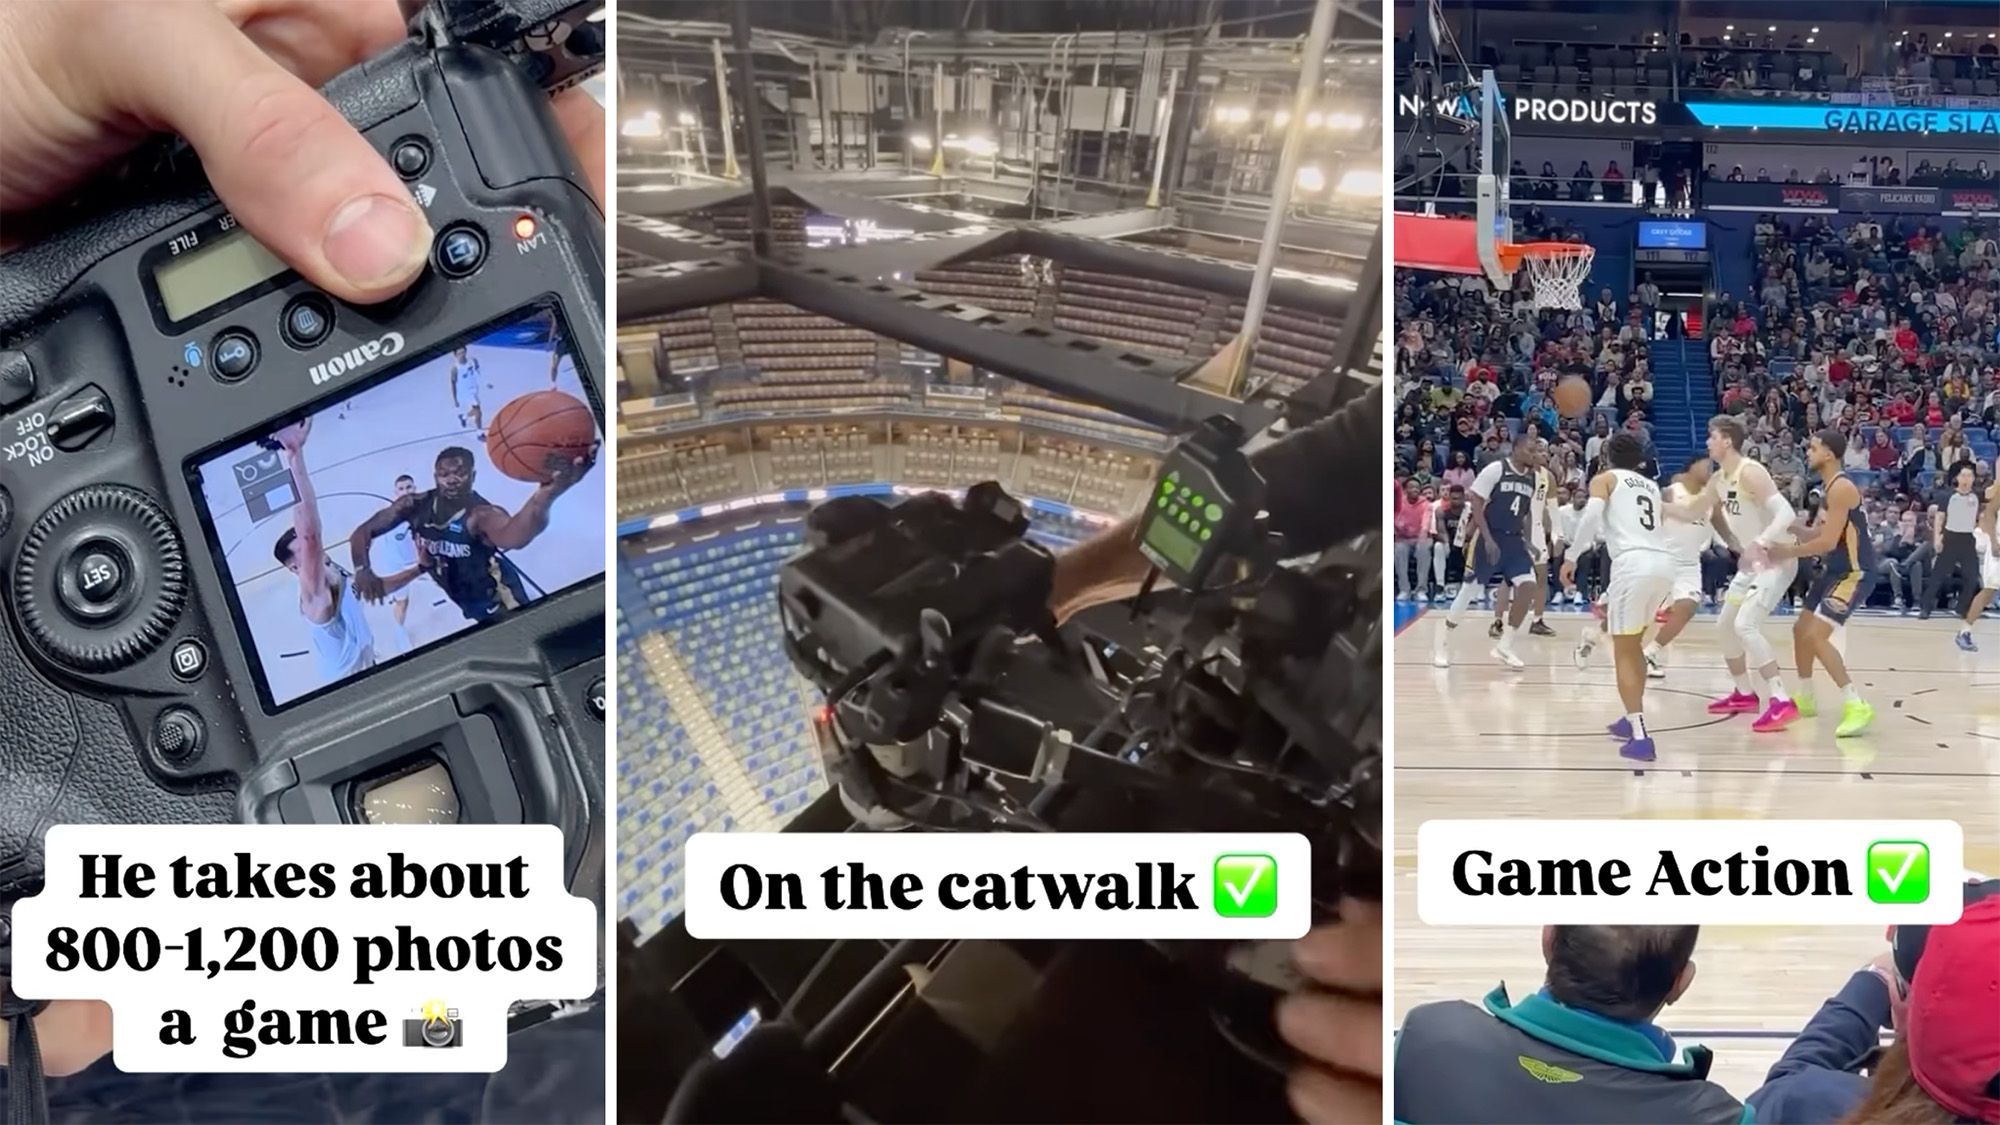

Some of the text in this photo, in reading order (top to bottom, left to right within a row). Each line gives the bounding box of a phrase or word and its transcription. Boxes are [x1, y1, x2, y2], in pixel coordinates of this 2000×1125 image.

[1515, 98, 1657, 125] PRODUCTS
[1825, 109, 2000, 133] GARAGE SLA
[168, 231, 199, 256] FILE
[516, 232, 547, 255] LAN
[309, 331, 405, 386] Canon
[16, 412, 45, 436] OFF
[3, 432, 48, 462] LOCK
[28, 446, 54, 468] ON
[1510, 494, 1521, 517] 4
[1637, 494, 1655, 532] 3
[83, 564, 111, 590] SET
